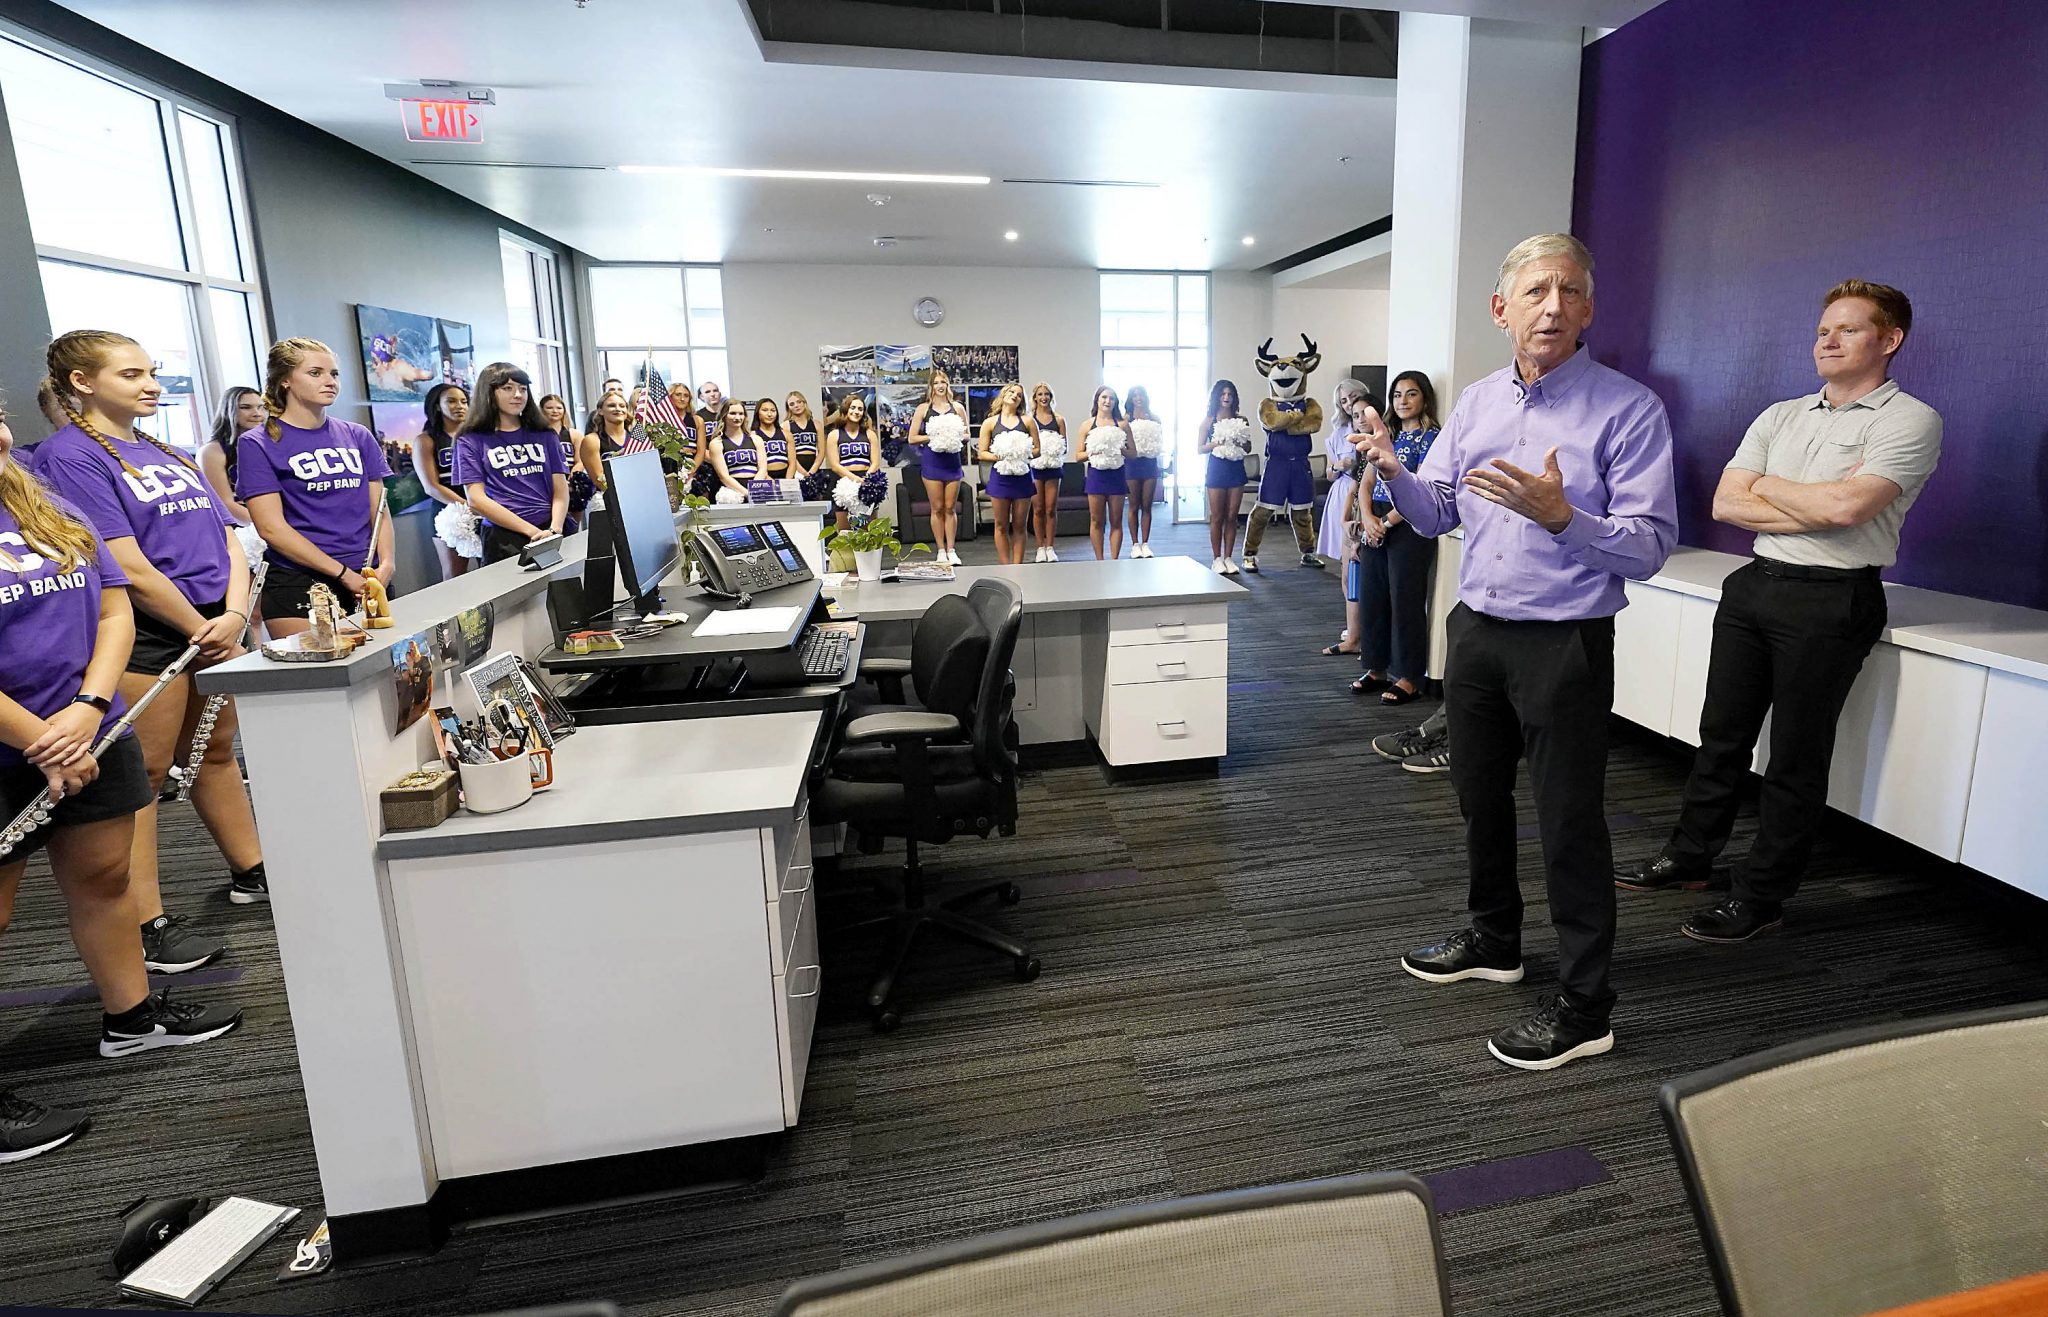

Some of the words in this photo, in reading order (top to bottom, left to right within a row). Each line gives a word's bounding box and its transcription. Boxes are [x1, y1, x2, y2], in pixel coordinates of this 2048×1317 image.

[418, 102, 468, 138] EXIT
[487, 443, 546, 469] GCU
[723, 449, 758, 467] GCU
[839, 442, 871, 458] GCU
[288, 447, 363, 480] GCU
[502, 469, 519, 478] PEP
[519, 465, 544, 476] BAND
[121, 463, 208, 503] GCU
[307, 481, 331, 492] PEP
[333, 478, 361, 490] BAND
[177, 496, 212, 512] BAND
[0, 583, 25, 604] EP
[29, 571, 86, 597] BAND
